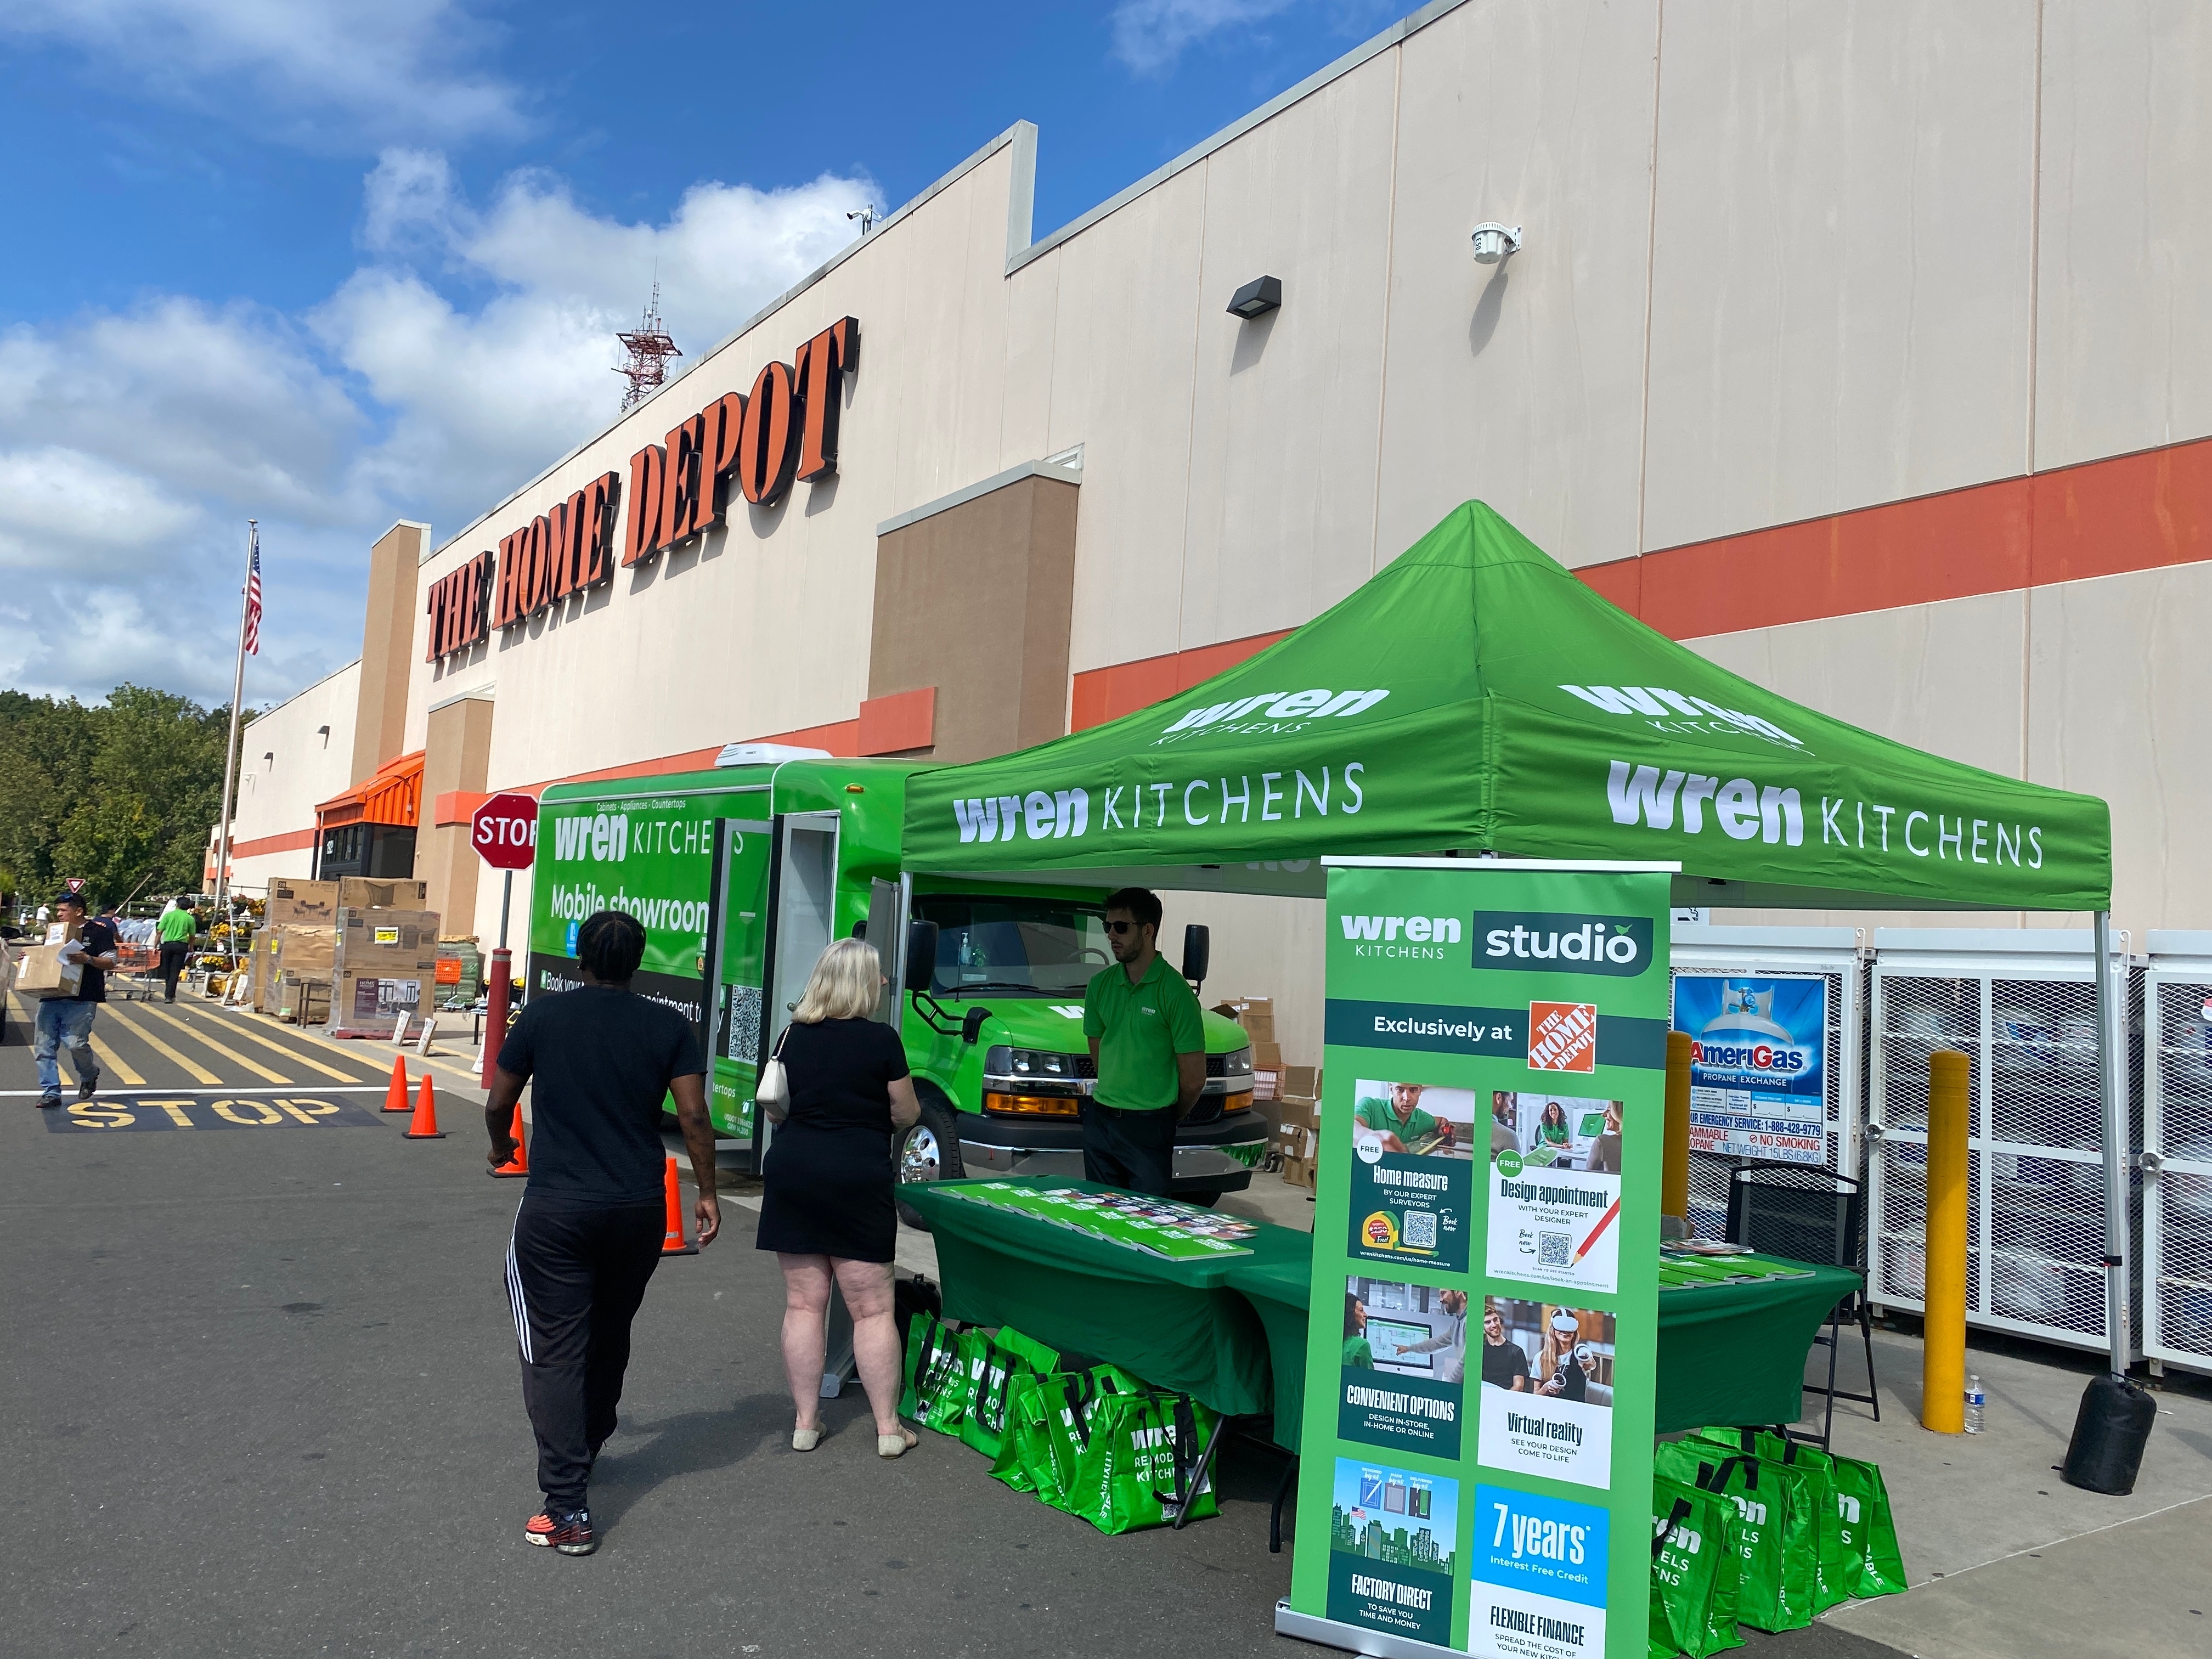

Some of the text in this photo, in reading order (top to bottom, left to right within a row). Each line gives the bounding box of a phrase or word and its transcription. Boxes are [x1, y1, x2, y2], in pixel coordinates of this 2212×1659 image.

[426, 315, 859, 664] THE HOME DEPOT
[1161, 689, 1390, 733] wren
[1556, 685, 1804, 744] wren
[1149, 722, 1312, 746] KITCHENS
[1645, 720, 1815, 756] KITC
[596, 800, 686, 812] Cabinets Appliances Countertops
[953, 761, 1365, 844] wren KITCHENS
[1606, 759, 2044, 870] wren KITCHENS
[555, 813, 743, 862] wren KITCHE
[551, 882, 603, 921] Mobile
[1340, 914, 1461, 943] wren
[1356, 944, 1444, 960] KITCHENS
[1486, 922, 1637, 964] studio
[546, 972, 563, 992] Book
[1374, 1016, 1513, 1042] Exclusively at
[1536, 1010, 1563, 1036] THE
[1530, 1005, 1595, 1069] HOME
[1553, 1030, 1594, 1070] DEPOT
[1691, 1041, 1803, 1069] AmeriGas
[713, 1082, 736, 1099] tertops
[1703, 1073, 1786, 1086] PROPANE EXCHANGE
[67, 1098, 340, 1128] STOP
[1700, 1114, 1733, 1127] EMERGENCY
[1735, 1118, 1763, 1130] SERVICE:
[1764, 1121, 1820, 1136] 1-888-428-9779
[1690, 1127, 1820, 1150] AMMABLE NO SMOKING
[1690, 1139, 1714, 1150] OPANE
[1723, 1142, 1735, 1153] NET
[1737, 1143, 1768, 1156] WEIGHT
[1500, 1160, 1520, 1168] FREE
[1374, 1165, 1448, 1191] Home measure
[1390, 1198, 1430, 1208] SURVEYORS
[1411, 1193, 1437, 1201] EXPERT
[1501, 1179, 1608, 1208] Design appointment
[1443, 1215, 1458, 1226] Book
[1534, 1215, 1571, 1224] DESIGNER
[1561, 1210, 1588, 1218] EXPERT
[1519, 1229, 1534, 1238] Book
[922, 1341, 964, 1376] ren
[1347, 1385, 1454, 1421] CONVENIENT OPTIONS
[1364, 1420, 1394, 1432] IN-HOME
[1408, 1429, 1434, 1439] ONLINE
[1369, 1413, 1430, 1430] DESIGN IN-STORE,
[1508, 1412, 1583, 1447] Virtual reality
[1131, 1425, 1176, 1451] wre
[1511, 1438, 1577, 1456] SEE YOUR DESIGN
[1135, 1453, 1173, 1467] REMOD
[1518, 1448, 1540, 1458] COME
[1554, 1454, 1570, 1463] LIFE
[1493, 1503, 1508, 1548] 7
[1491, 1555, 1588, 1584] Interest Free Credit
[1351, 1573, 1432, 1611] FACTORY DIRECT
[1359, 1610, 1421, 1630] TIME AND MONEY
[1379, 1606, 1396, 1615] SAVE
[1398, 1610, 1413, 1619] YOU
[1491, 1605, 1584, 1646] FLEXIBLE FINANCE
[1495, 1633, 1525, 1645] SPREAD
[1527, 1641, 1542, 1650] THE
[1544, 1645, 1564, 1655] COST
[1497, 1643, 1517, 1654] YOUR
[1520, 1648, 1539, 1658] NEW
